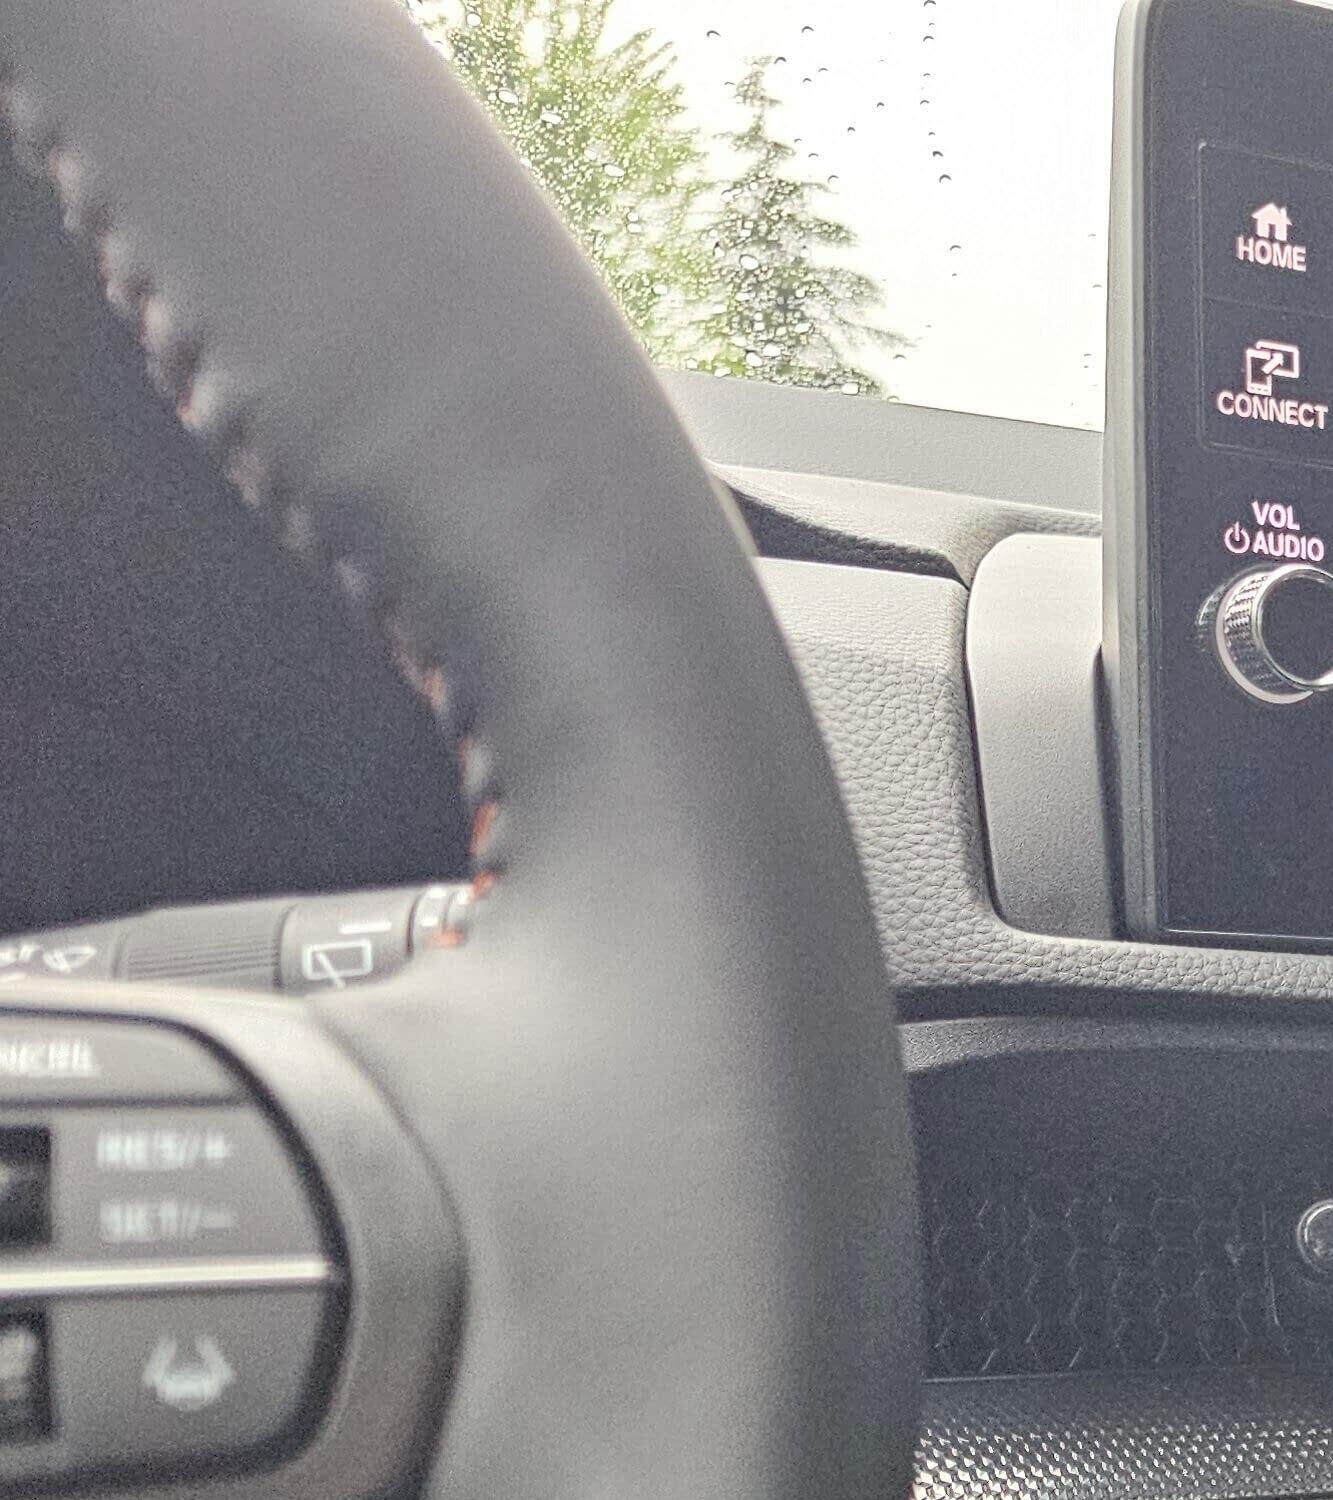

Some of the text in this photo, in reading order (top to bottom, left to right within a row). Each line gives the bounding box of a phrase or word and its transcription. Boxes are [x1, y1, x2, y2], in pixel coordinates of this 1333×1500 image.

[1236, 234, 1307, 272] HOME
[1217, 391, 1329, 429] CONNECT
[1251, 500, 1300, 531] VOL
[1252, 530, 1325, 562] AUDIO
